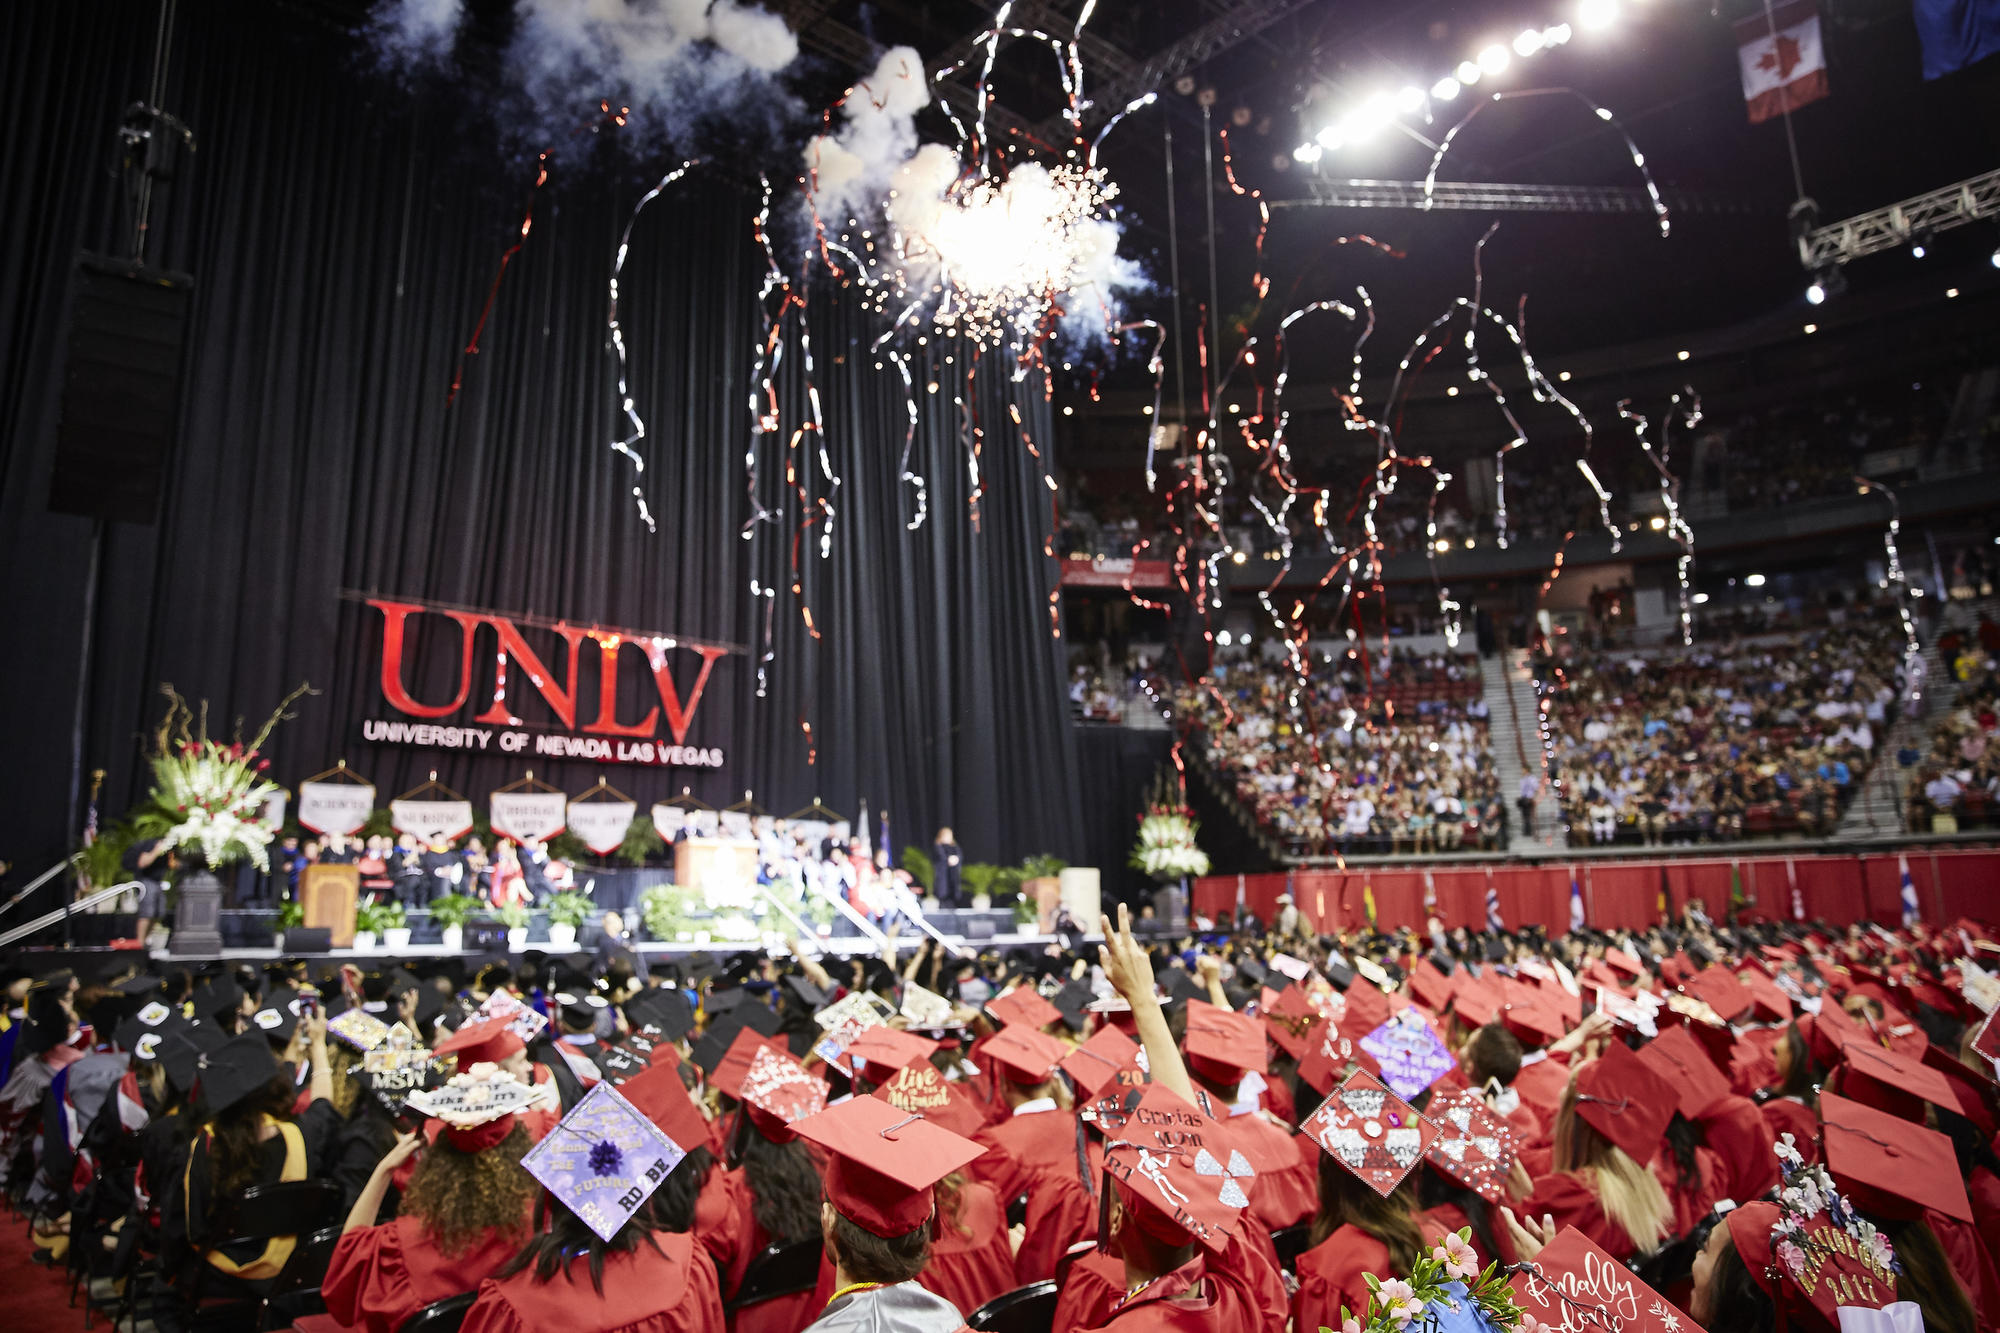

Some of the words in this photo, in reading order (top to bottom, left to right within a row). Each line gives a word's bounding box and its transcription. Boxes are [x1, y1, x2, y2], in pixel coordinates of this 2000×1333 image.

[365, 599, 728, 744] UNLV
[363, 719, 492, 750] UNIVERSITY
[499, 731, 530, 752] OF
[535, 733, 612, 761] NEVADA
[616, 741, 656, 764] LAS
[660, 744, 725, 769] VEGAS
[1136, 1107, 1204, 1128] Gracias
[573, 1176, 630, 1196] FUTURE
[1825, 1273, 1879, 1306] 2017
